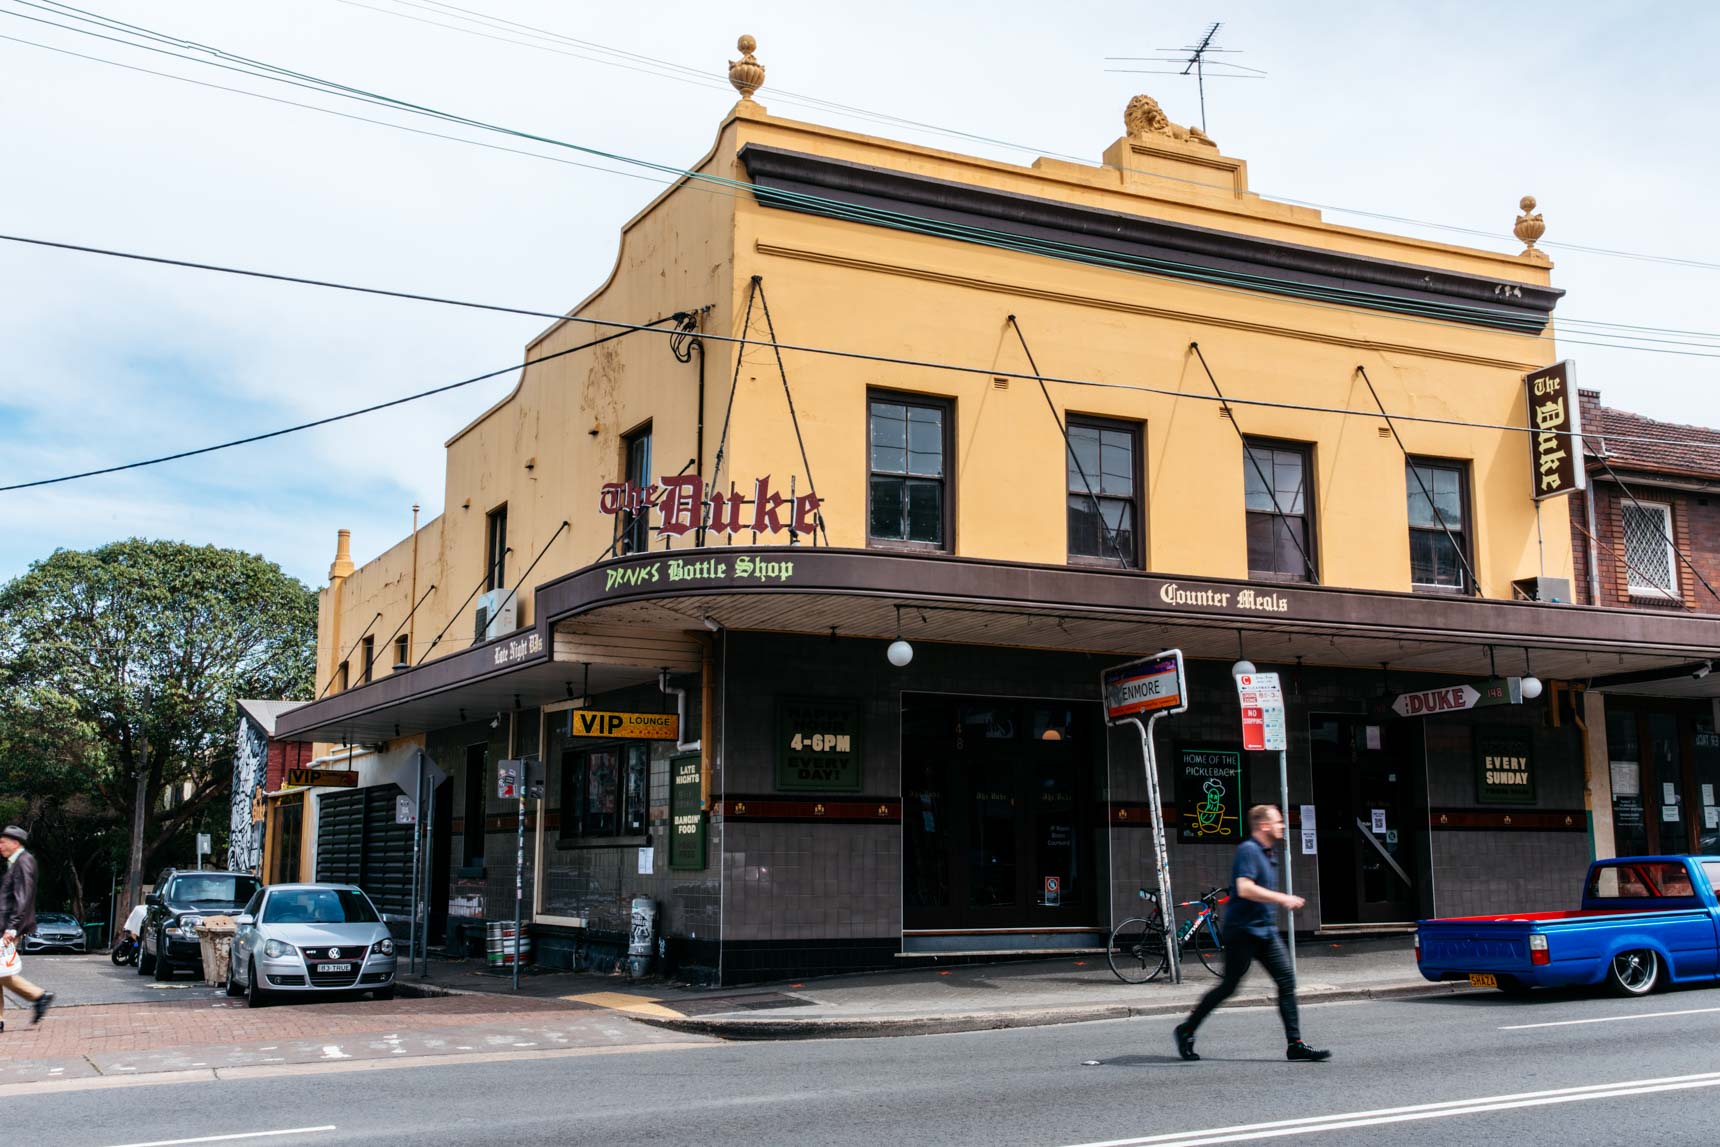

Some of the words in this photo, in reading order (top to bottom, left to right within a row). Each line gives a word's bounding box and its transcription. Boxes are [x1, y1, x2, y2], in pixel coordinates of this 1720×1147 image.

[1533, 376, 1561, 396] The
[1535, 396, 1567, 491] Duke
[599, 480, 659, 518] The
[656, 474, 821, 538] Duke
[668, 559, 727, 582] Bottle
[734, 556, 794, 582] Shop
[1160, 583, 1231, 607] Counter
[1236, 589, 1288, 612] Meals
[494, 647, 508, 665] Late
[509, 639, 527, 662] Night
[1122, 680, 1161, 701] ENMORE
[1409, 688, 1466, 714] DUKE
[580, 714, 623, 735] VIP
[629, 716, 671, 726] LOUNGE
[790, 733, 851, 752] 4-6PM
[1183, 754, 1207, 763] HOME
[1208, 755, 1220, 764] OF
[1222, 756, 1237, 765] THE
[1485, 756, 1526, 770] EVERY
[292, 771, 322, 784] VIP
[676, 773, 700, 784] NIGHTS
[680, 765, 695, 775] LATE
[1185, 766, 1236, 777] PICKLEBACK
[1486, 771, 1528, 785] SUNDAY
[678, 825, 696, 834] FOOD
